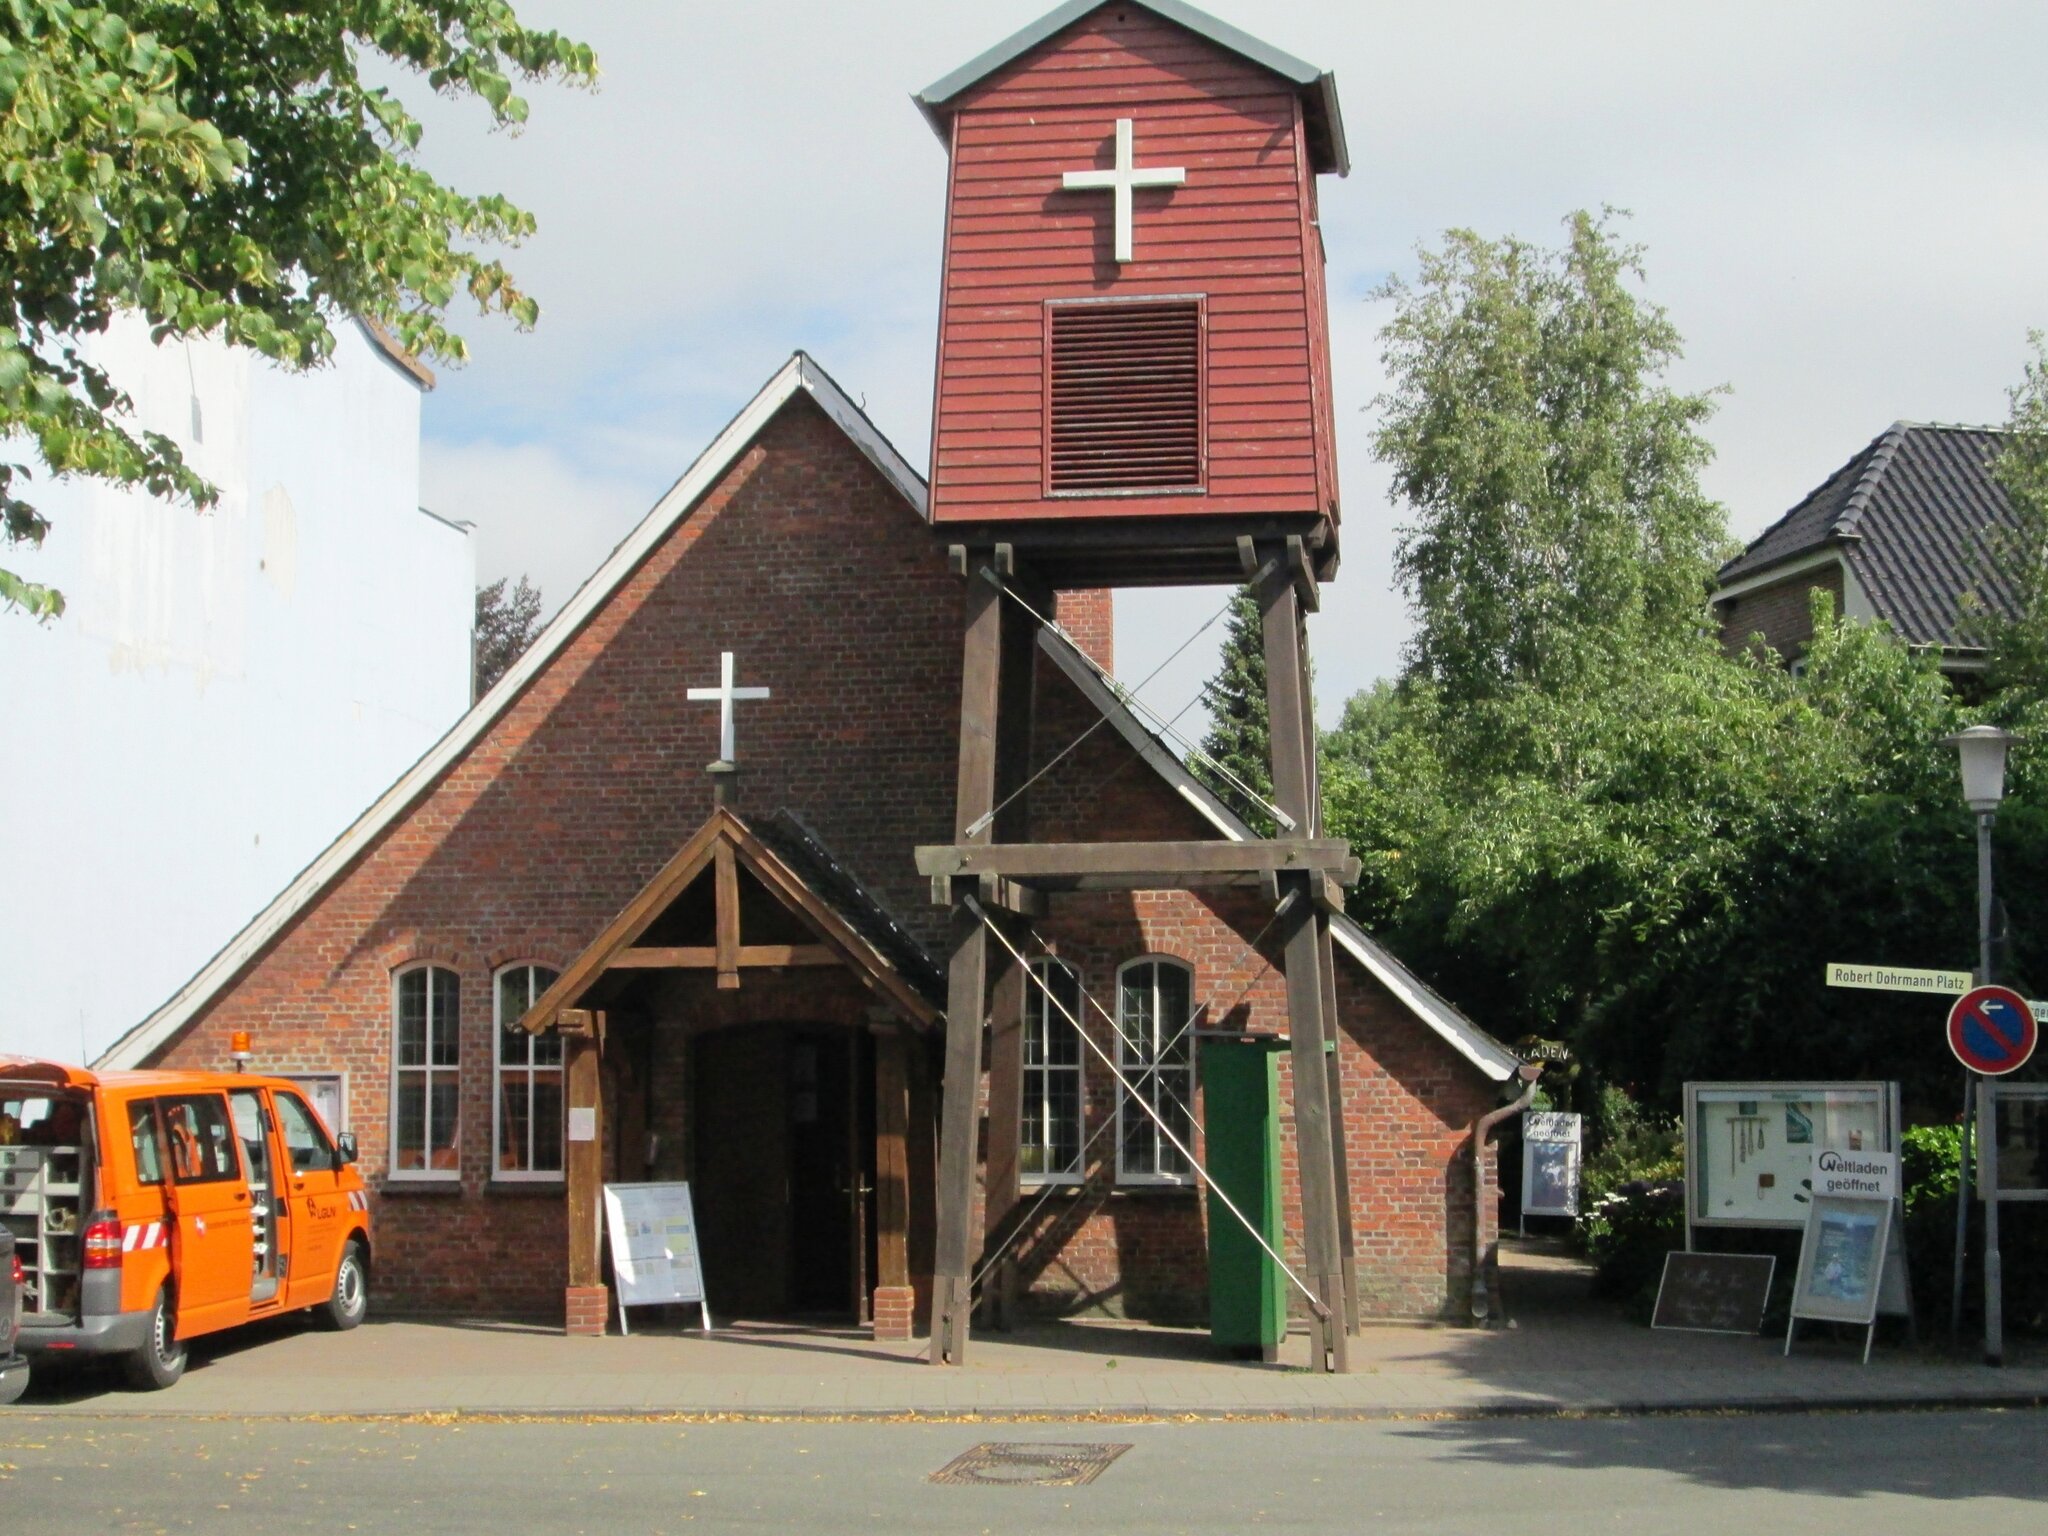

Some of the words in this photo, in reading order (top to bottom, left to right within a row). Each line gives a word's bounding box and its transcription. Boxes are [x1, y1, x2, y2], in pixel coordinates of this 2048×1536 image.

[1834, 968, 1873, 983] Robert
[1876, 971, 1934, 987] Dohrmann
[1936, 975, 1964, 990] Platz
[1819, 1151, 1888, 1175] Weltladen
[1827, 1178, 1880, 1192] geöffnet
